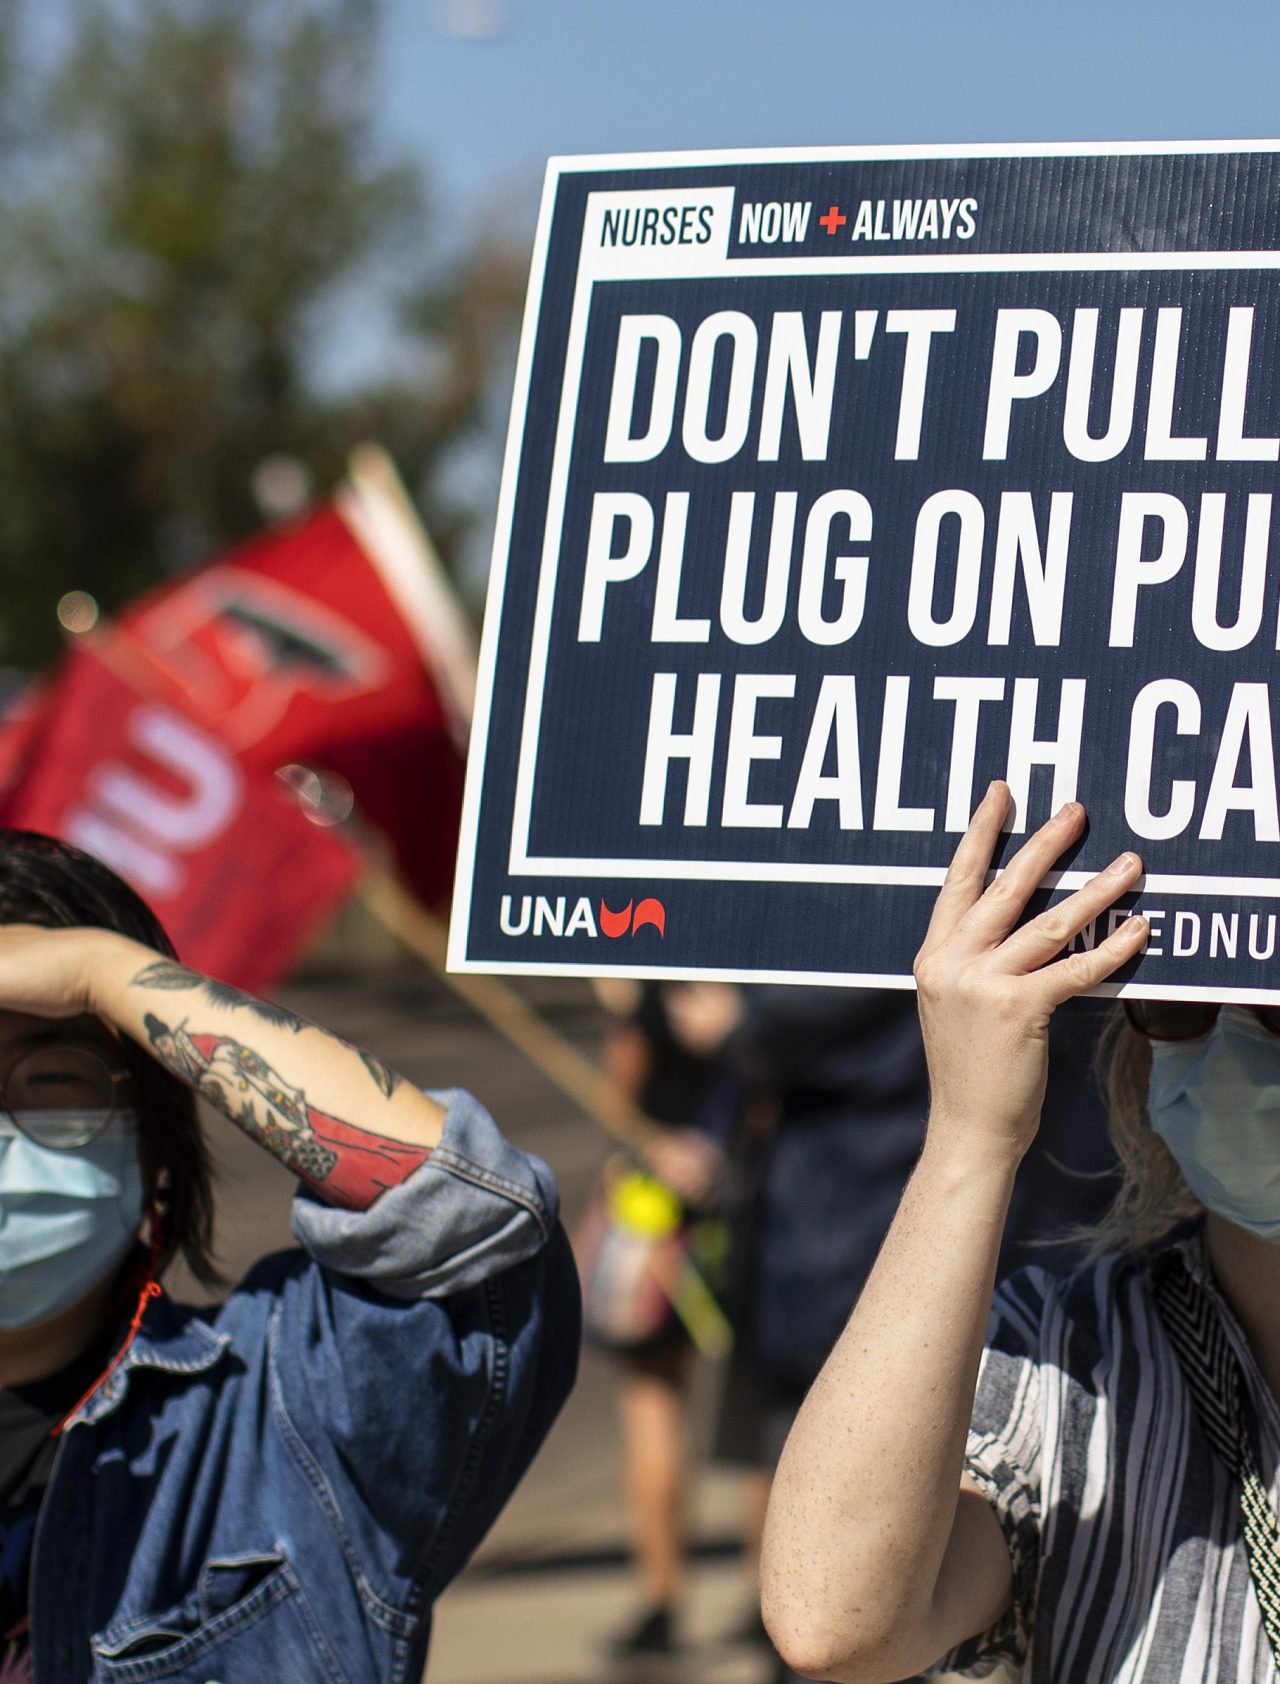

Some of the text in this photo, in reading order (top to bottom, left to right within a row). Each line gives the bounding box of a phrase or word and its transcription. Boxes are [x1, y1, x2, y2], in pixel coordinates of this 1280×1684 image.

[601, 206, 714, 247] NURSES
[739, 201, 812, 244] NOW
[852, 197, 978, 241] ALWAYS
[603, 309, 957, 463] DON'T
[982, 307, 1280, 463] PULL
[577, 489, 873, 648] PLUG
[907, 489, 1074, 648] ON
[639, 672, 1087, 833] HEALTH
[499, 895, 598, 937] UNA
